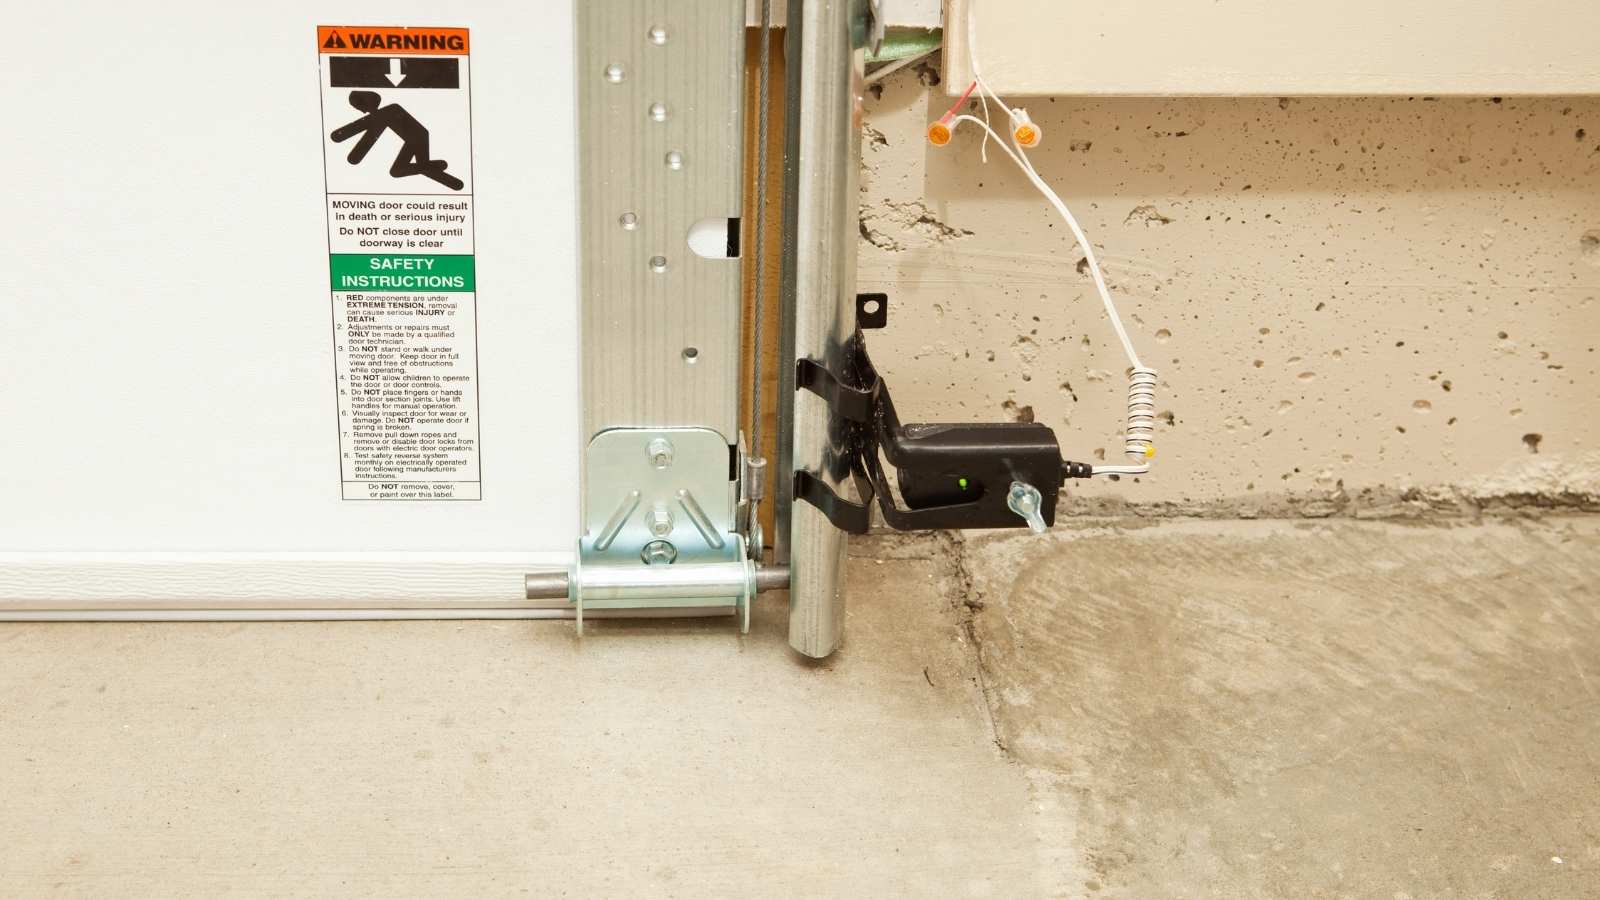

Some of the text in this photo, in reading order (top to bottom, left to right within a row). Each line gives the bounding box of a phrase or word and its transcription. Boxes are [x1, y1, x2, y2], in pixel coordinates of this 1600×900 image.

[349, 34, 464, 50] WARNING
[436, 214, 465, 223] injury
[360, 239, 403, 248] doorway
[419, 240, 443, 248] clear
[370, 258, 434, 270] SAFETY
[342, 276, 464, 287] INSTRUCTIONS
